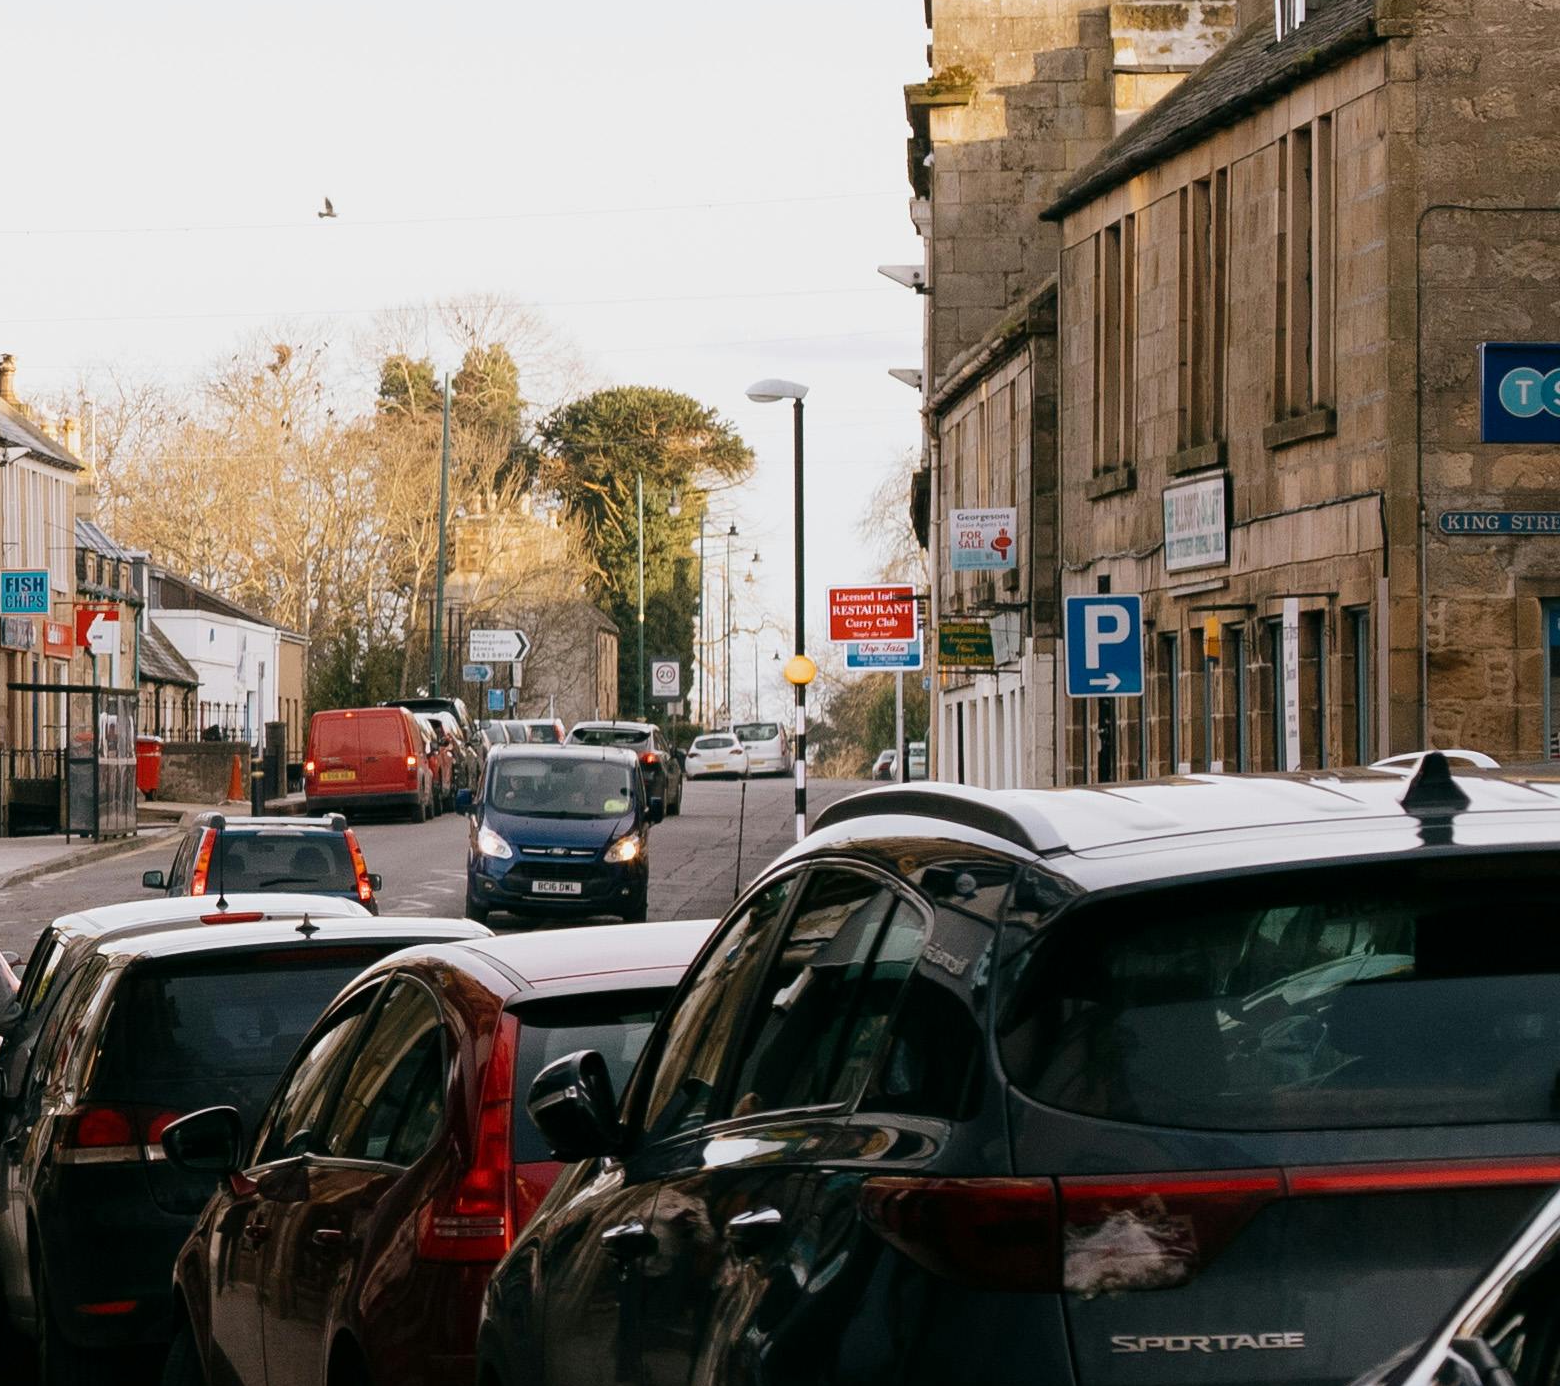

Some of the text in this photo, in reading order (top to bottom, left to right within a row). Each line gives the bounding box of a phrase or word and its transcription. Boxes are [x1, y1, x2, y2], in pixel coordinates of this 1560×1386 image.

[1447, 515, 1501, 530] KING
[960, 530, 981, 540] FOR
[958, 539, 985, 549] SALE
[5, 577, 44, 592] FISH
[5, 596, 44, 609] CHIPS
[836, 591, 874, 602] Licensed
[832, 603, 911, 616] RESTAURANT
[845, 617, 898, 629] Curry Club
[1084, 604, 1131, 669] P
[659, 670, 673, 679] 20
[1110, 1332, 1305, 1354] SPORTAGE
